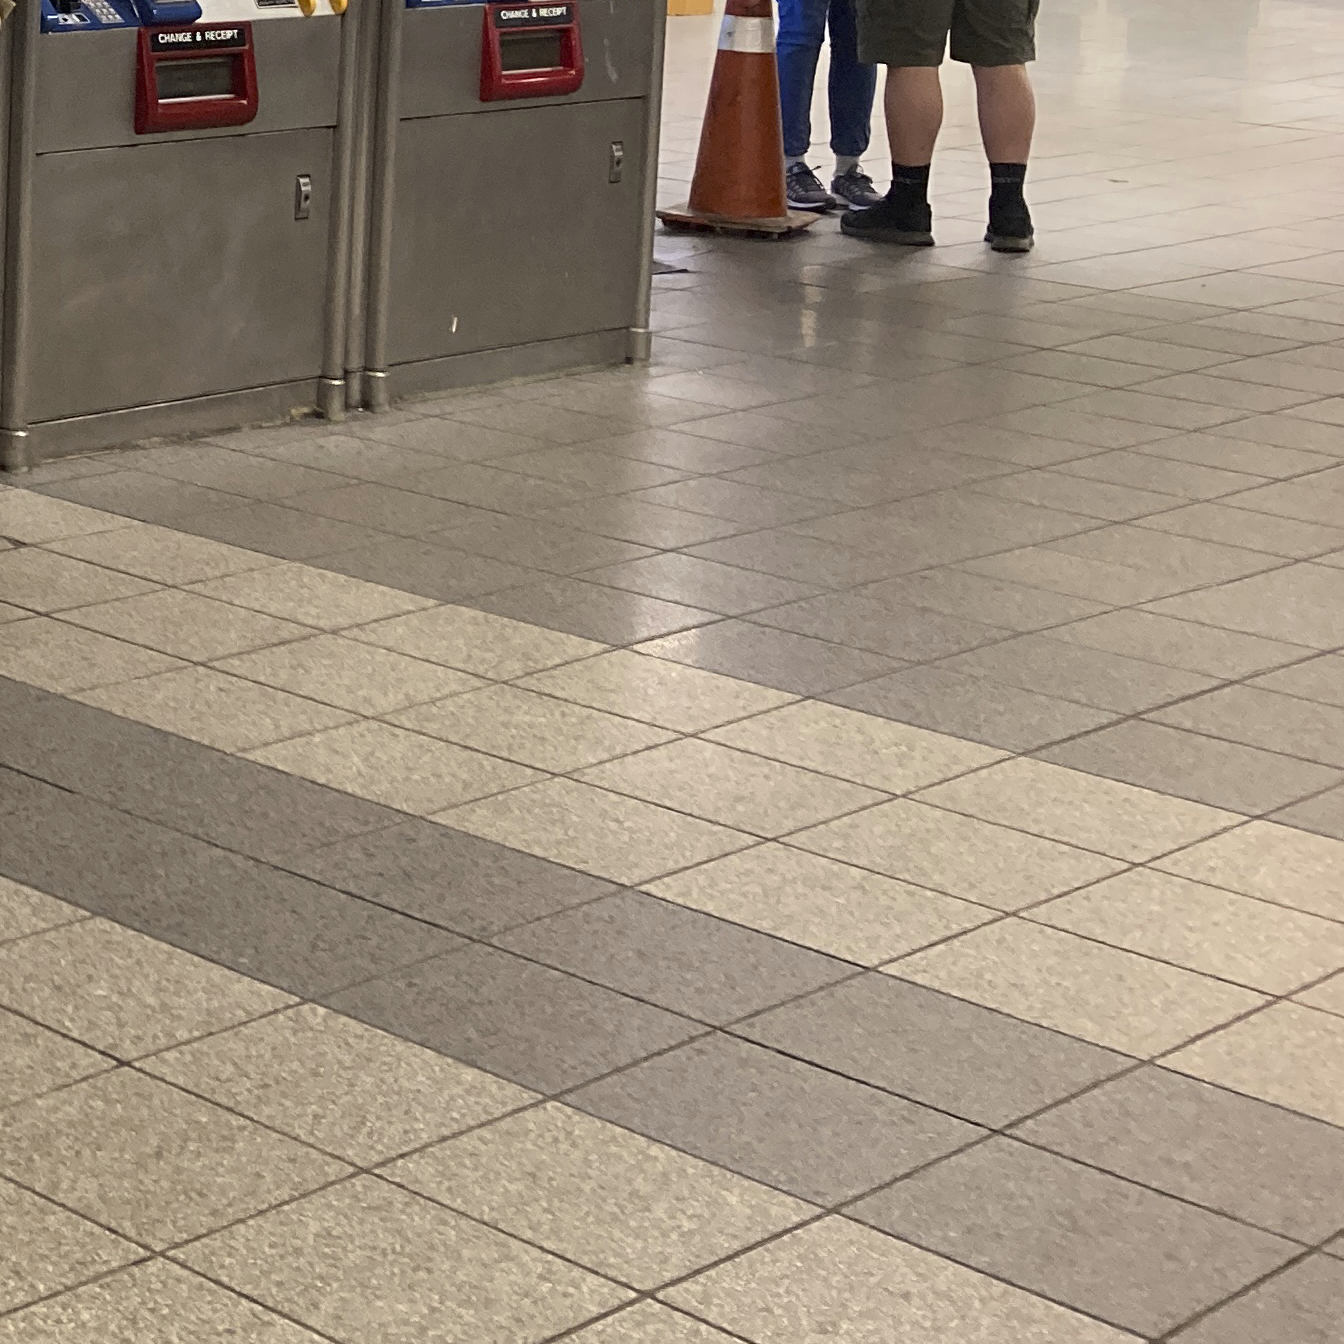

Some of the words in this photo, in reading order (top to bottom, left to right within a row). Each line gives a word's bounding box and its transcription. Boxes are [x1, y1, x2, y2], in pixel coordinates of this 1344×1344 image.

[539, 6, 567, 17] RECEIPT
[158, 32, 192, 44] CHANGE
[204, 29, 238, 41] RECEIPT
